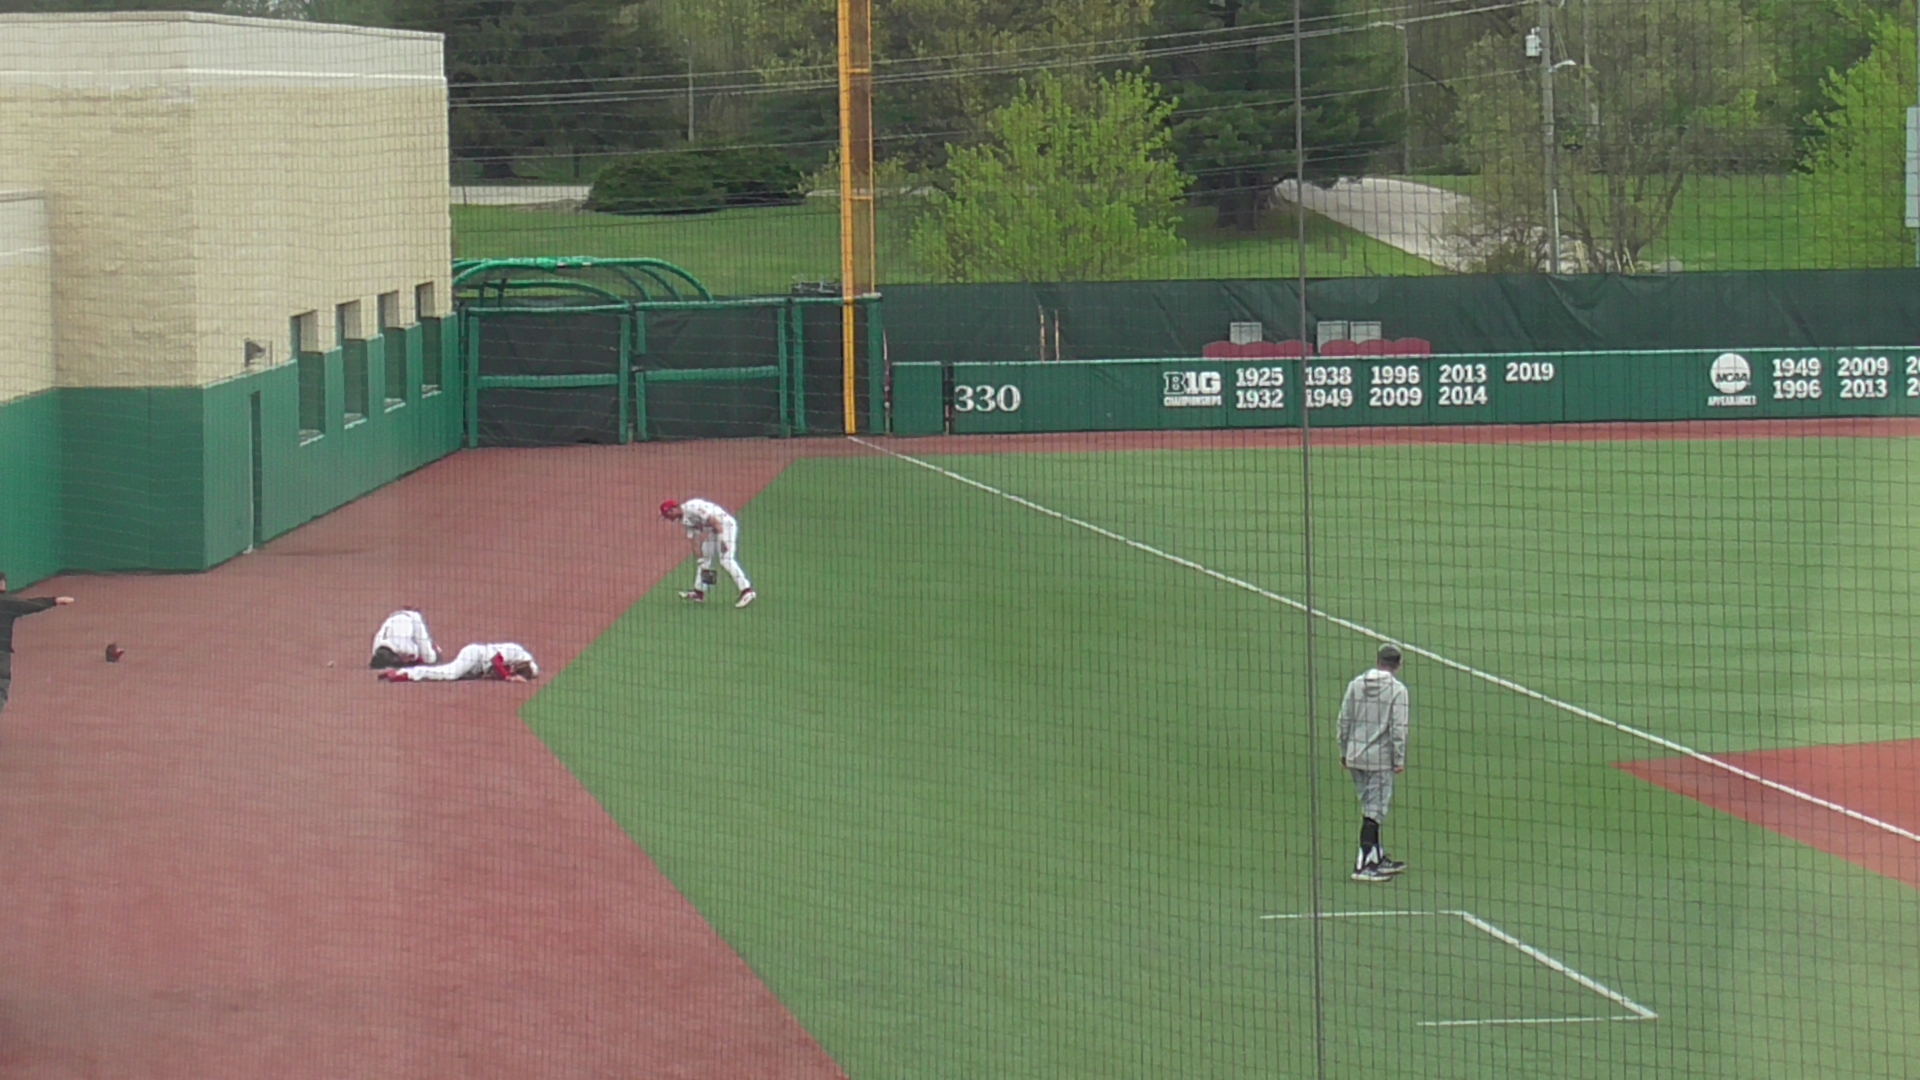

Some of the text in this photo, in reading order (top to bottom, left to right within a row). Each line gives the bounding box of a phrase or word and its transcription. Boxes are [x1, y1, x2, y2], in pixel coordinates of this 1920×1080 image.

[1235, 362, 1555, 387] 1925 1938 1996 2013 2019
[1772, 357, 1822, 378] 1949
[1837, 356, 1890, 377] 2009
[954, 384, 1021, 413] 330
[1235, 386, 1488, 409] 1932 1949 2009 2014
[1772, 379, 1822, 400] 1996
[1839, 378, 1889, 399] 2013
